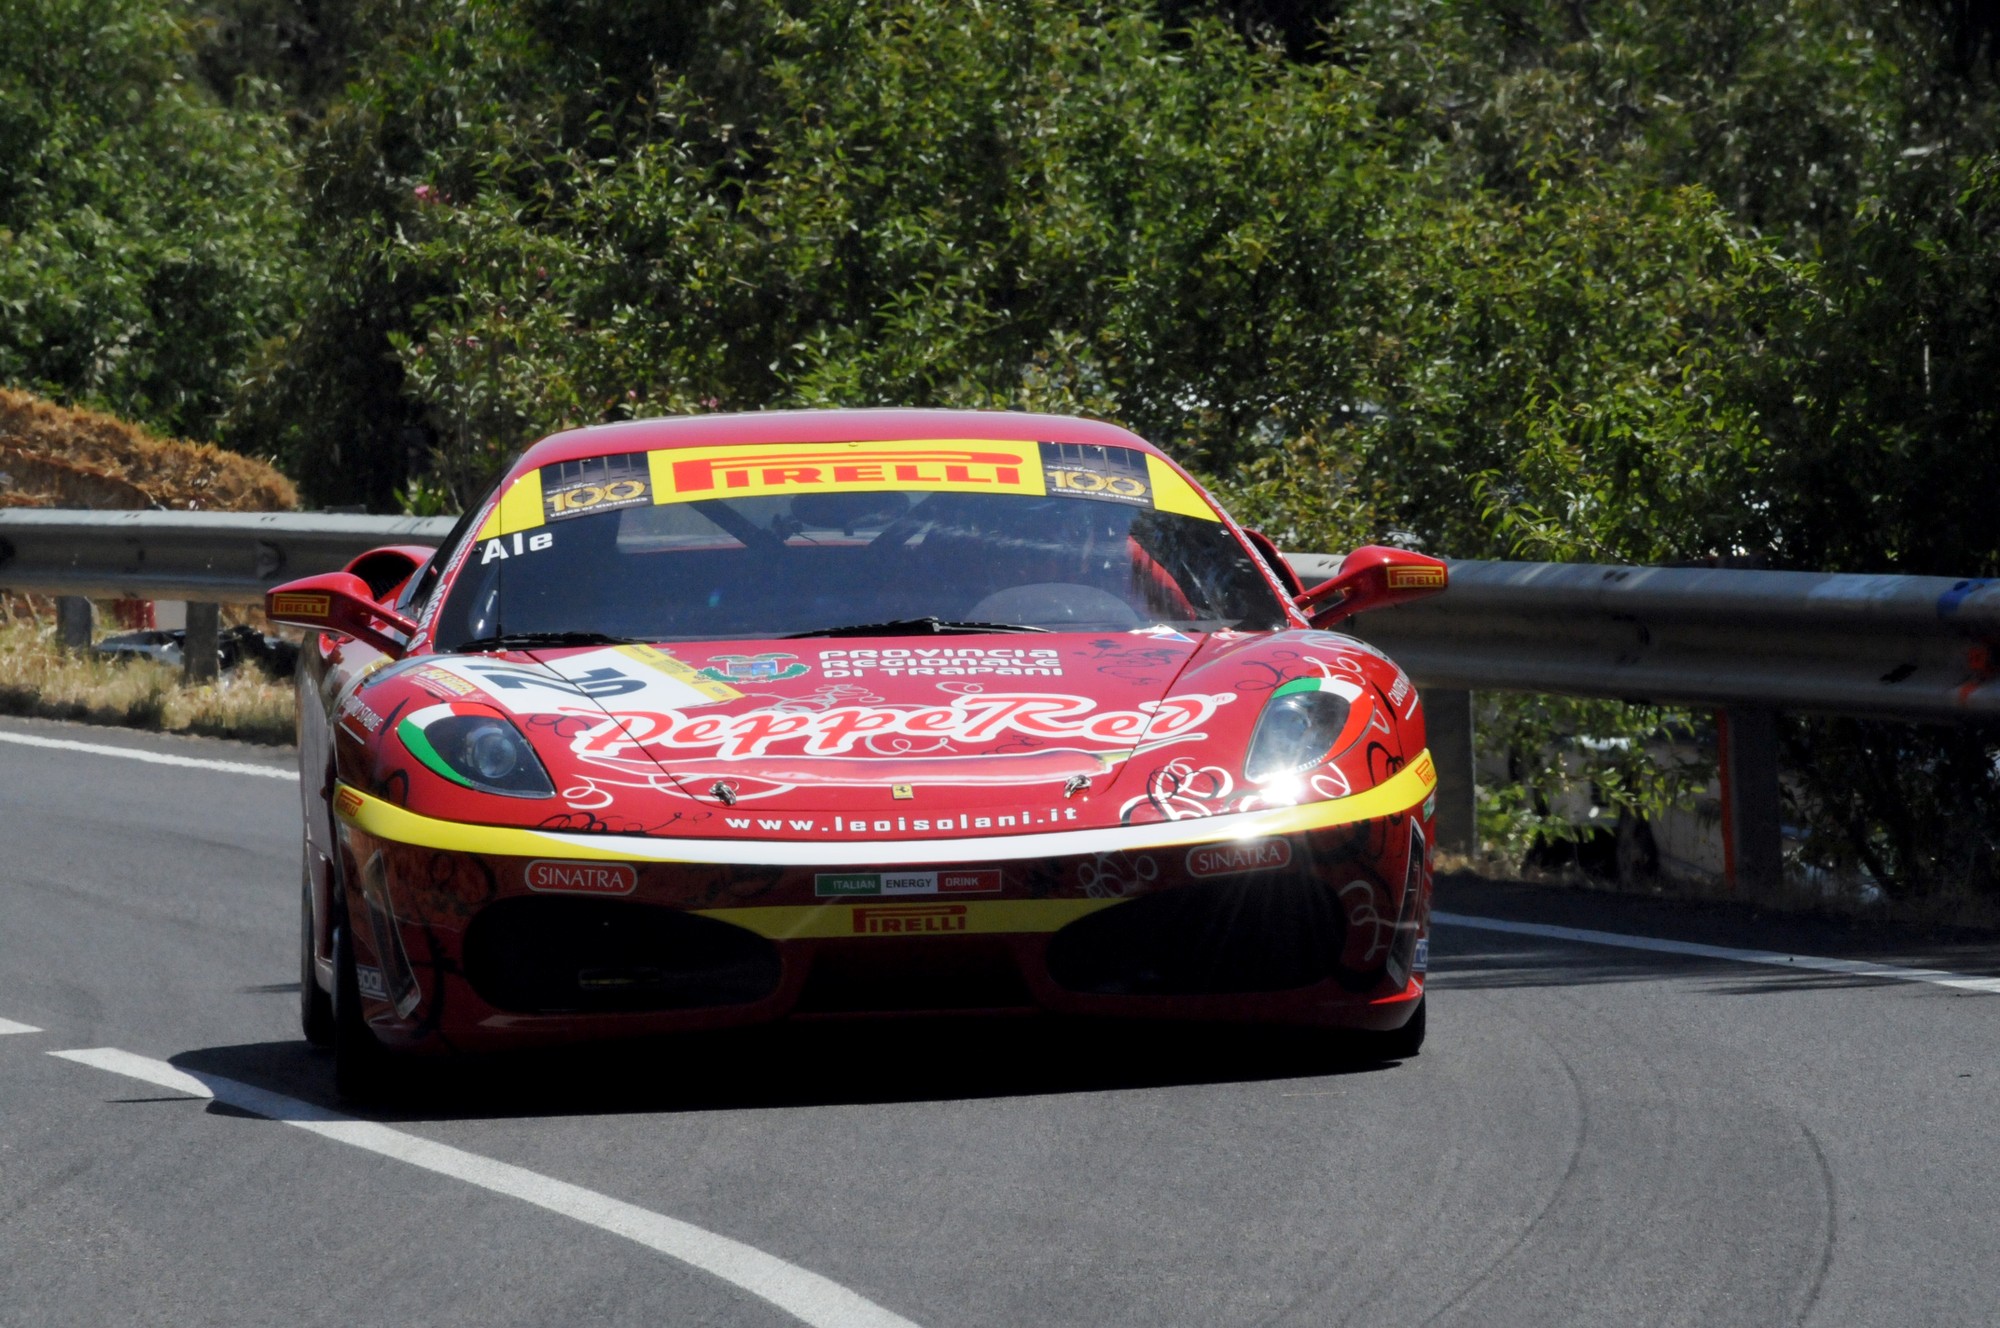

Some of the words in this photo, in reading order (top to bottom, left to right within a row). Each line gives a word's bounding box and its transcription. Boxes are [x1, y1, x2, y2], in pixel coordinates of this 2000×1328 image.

[672, 451, 1023, 493] PIRELLI
[1046, 470, 1147, 497] 100
[546, 480, 646, 512] 100
[481, 532, 553, 565] Ale
[1389, 567, 1443, 587] PIRELLI
[274, 596, 328, 615] PIRELLI
[823, 668, 864, 678] DI
[725, 806, 1078, 833] www.leoisolani.it
[1199, 845, 1282, 872] SINATRA
[537, 866, 625, 889] SINATRA
[833, 879, 876, 890] ITALIAN
[886, 877, 932, 889] ENERGY
[945, 876, 979, 888] DRINK
[852, 905, 967, 933] PIRELLI
